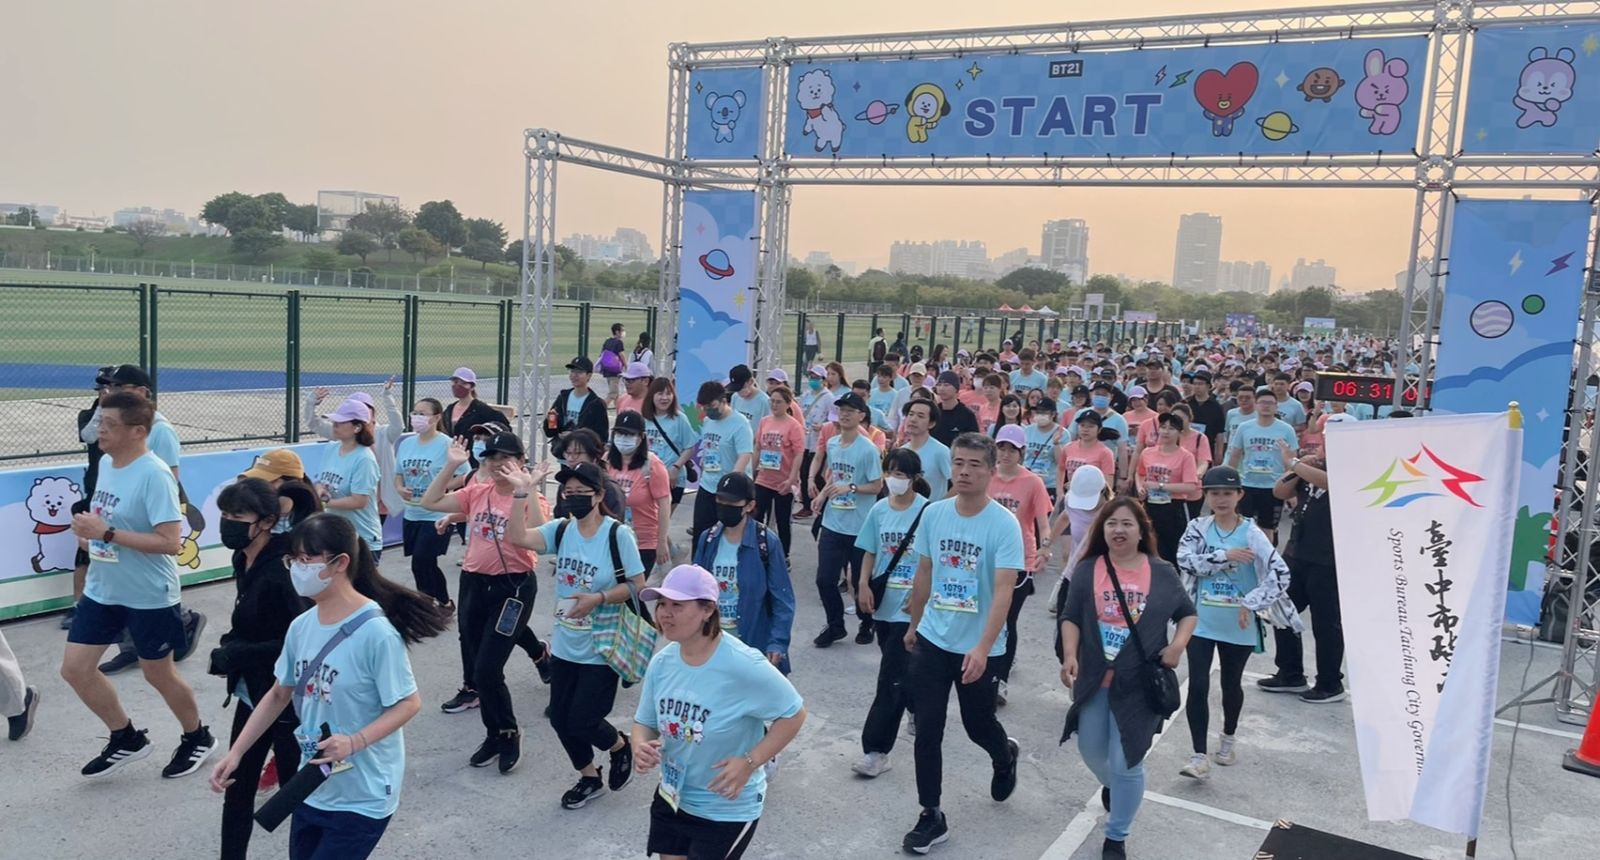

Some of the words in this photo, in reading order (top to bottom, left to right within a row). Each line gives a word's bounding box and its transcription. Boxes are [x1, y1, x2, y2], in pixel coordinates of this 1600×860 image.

[1051, 61, 1081, 75] BT21
[964, 94, 1162, 138] START
[1333, 381, 1393, 400] 06:31
[940, 539, 982, 557] SPORTS
[1387, 528, 1404, 571] Sports
[558, 557, 598, 577] SPORTS
[943, 584, 968, 593] 10791
[1400, 626, 1418, 686] Taichung
[660, 698, 711, 723] SPORTS
[1405, 690, 1422, 716] City
